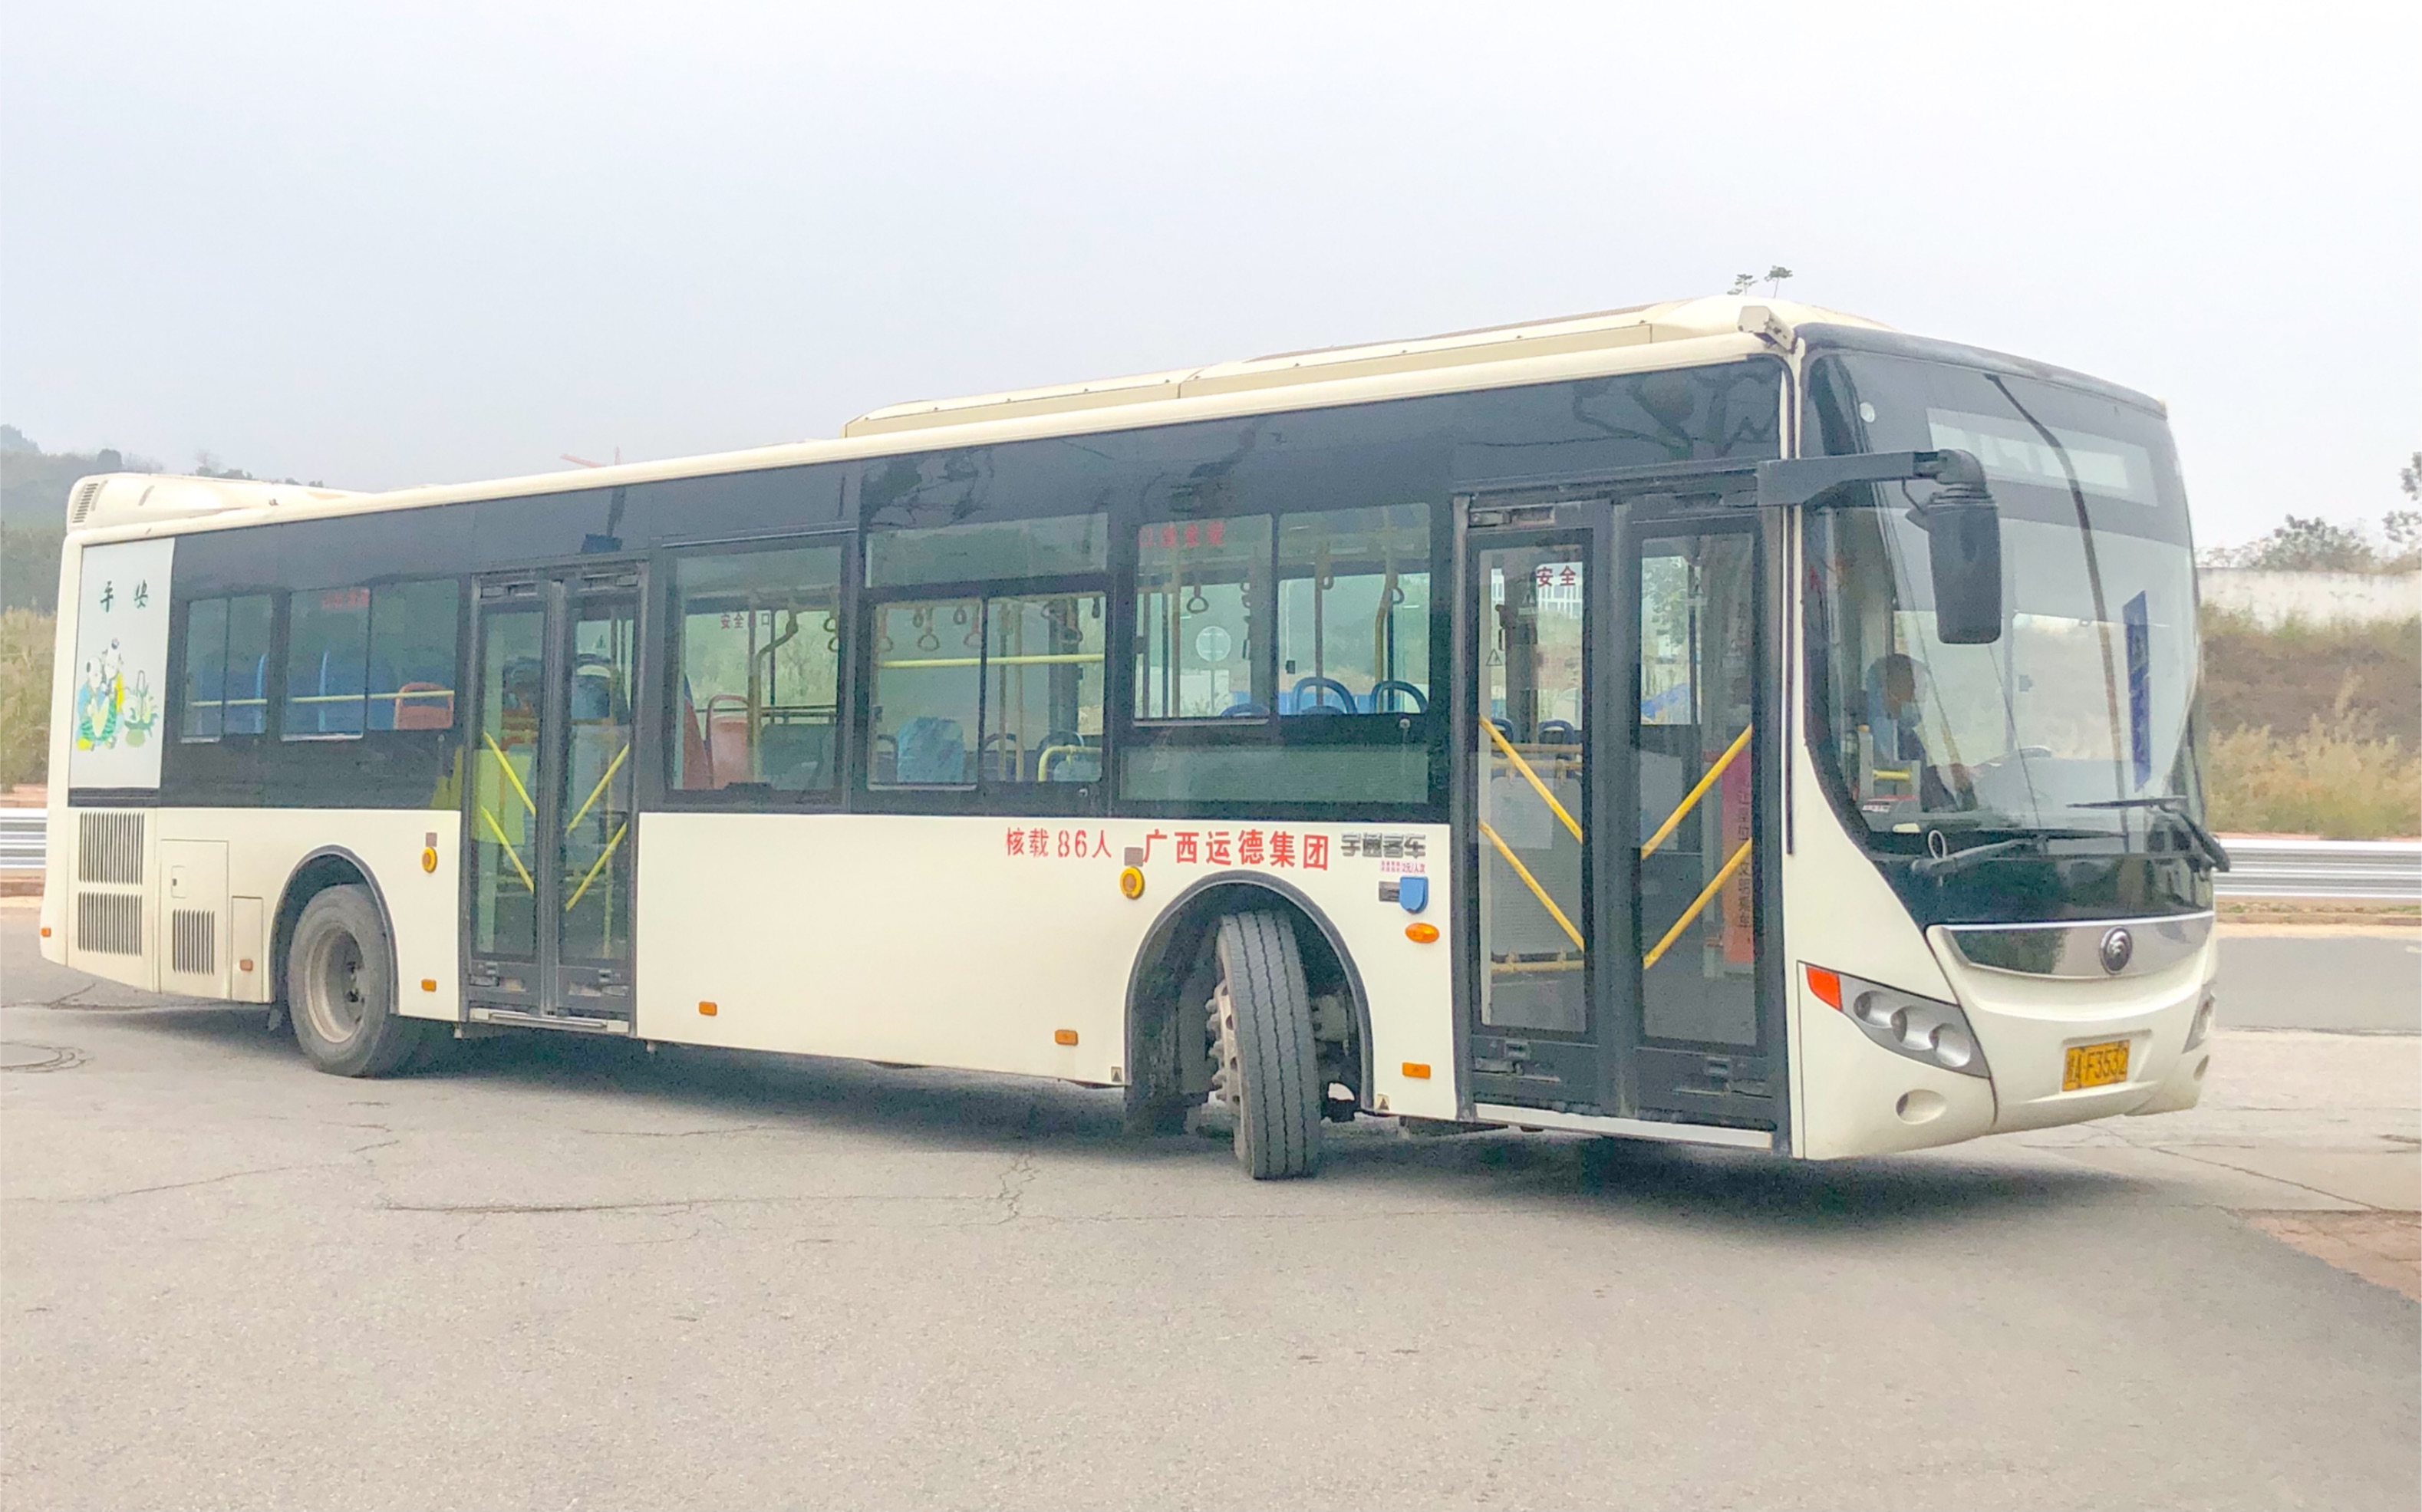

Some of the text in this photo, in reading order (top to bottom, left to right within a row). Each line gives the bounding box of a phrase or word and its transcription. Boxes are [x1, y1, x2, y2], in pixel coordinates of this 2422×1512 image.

[1536, 565, 1576, 588] 安全
[720, 611, 769, 630] 安全口
[1007, 827, 1112, 858] 核载86人
[1143, 828, 1329, 871] 广西运德集团
